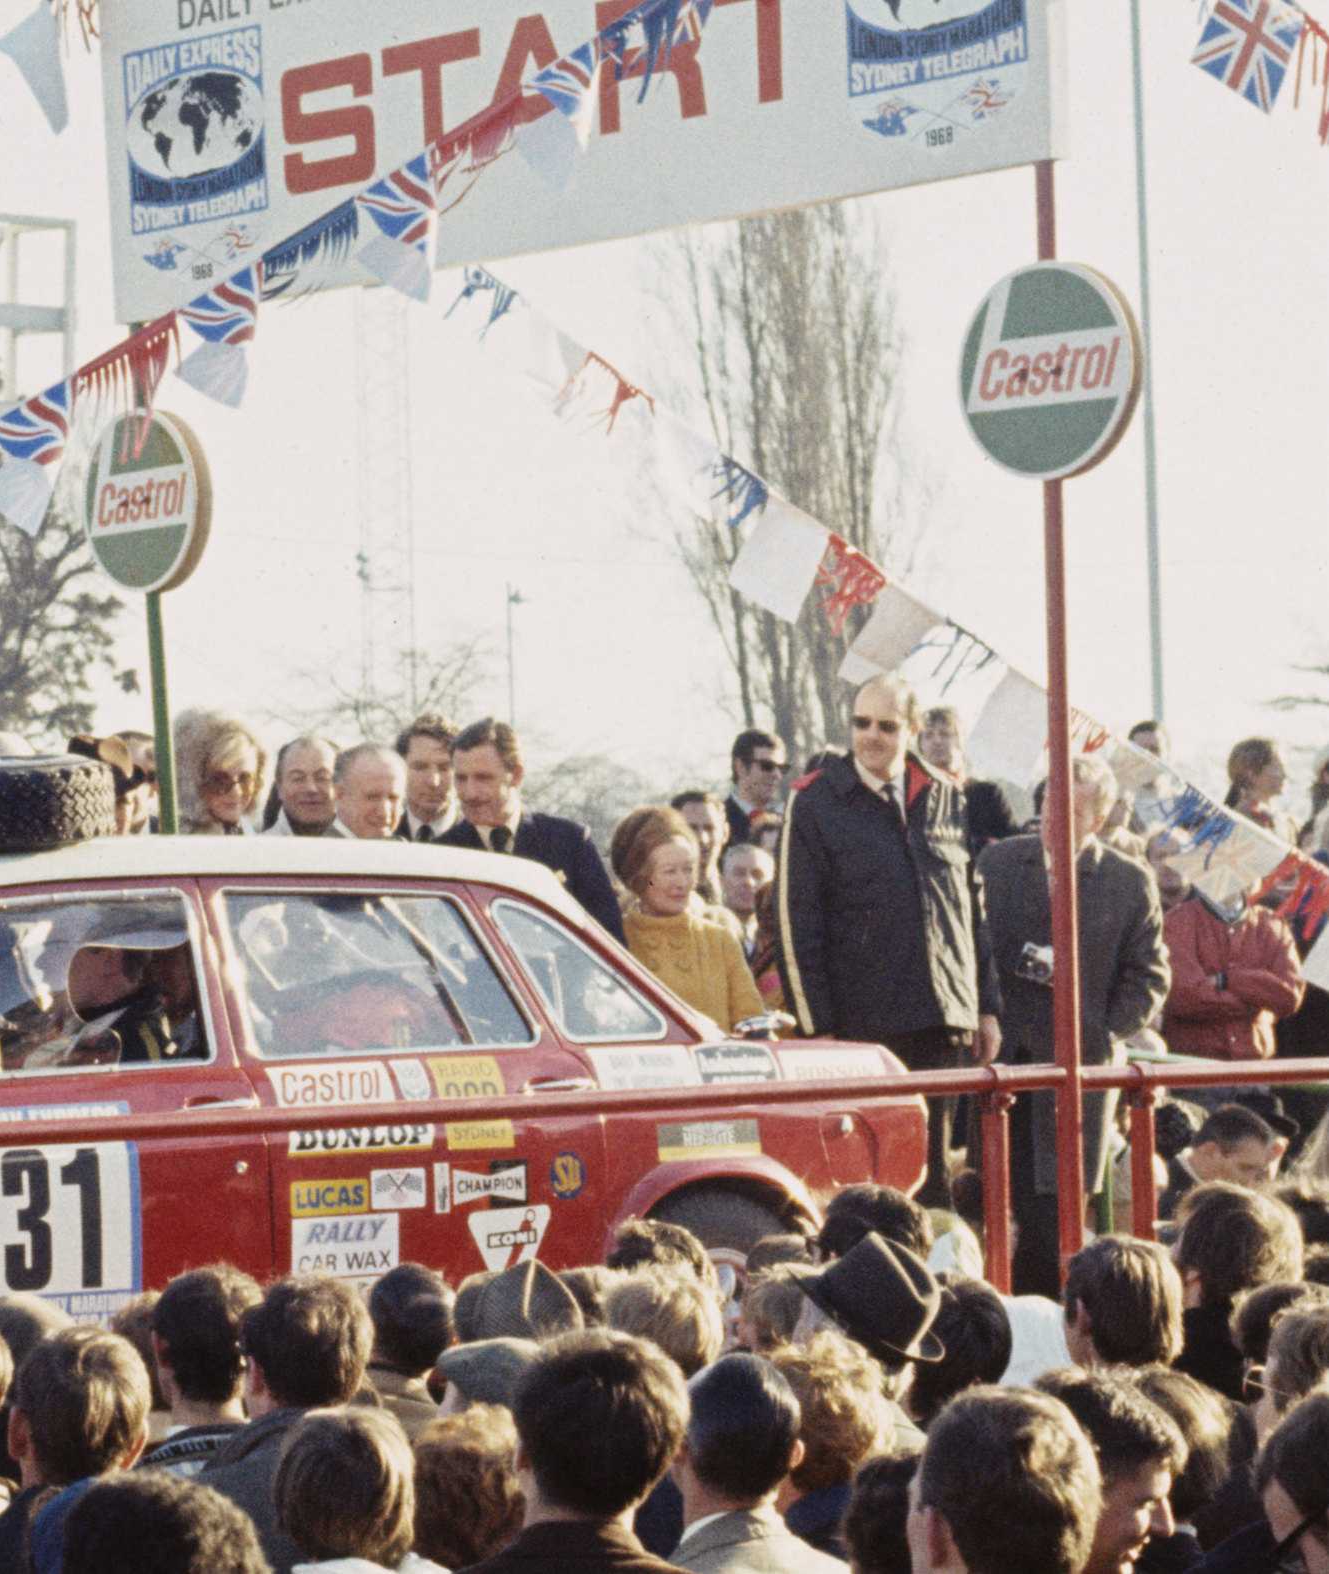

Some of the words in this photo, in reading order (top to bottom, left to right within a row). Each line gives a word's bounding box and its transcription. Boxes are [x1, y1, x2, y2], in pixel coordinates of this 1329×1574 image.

[126, 48, 178, 107] DAILY
[179, 28, 262, 79] EXPRESS
[851, 60, 922, 94] SYDNEY
[923, 26, 1025, 81] TELEGRAPH
[281, 0, 783, 194] START
[925, 126, 954, 148] 1968
[133, 203, 186, 234] SYDNEY
[188, 178, 267, 223] TELEGRAPH
[977, 336, 1122, 401] Castrol
[97, 471, 187, 528] Castrol
[437, 1061, 494, 1078] RADIO
[280, 1068, 382, 1106] Castrol
[295, 1123, 430, 1151] DUNLOP
[295, 1184, 365, 1209] LUCAS
[456, 1175, 523, 1195] CHAMPION
[0, 1147, 103, 1292] 31
[306, 1217, 389, 1246] RALLY
[489, 1230, 536, 1247] KONI
[297, 1253, 338, 1274] CAR
[344, 1249, 392, 1270] WAX
